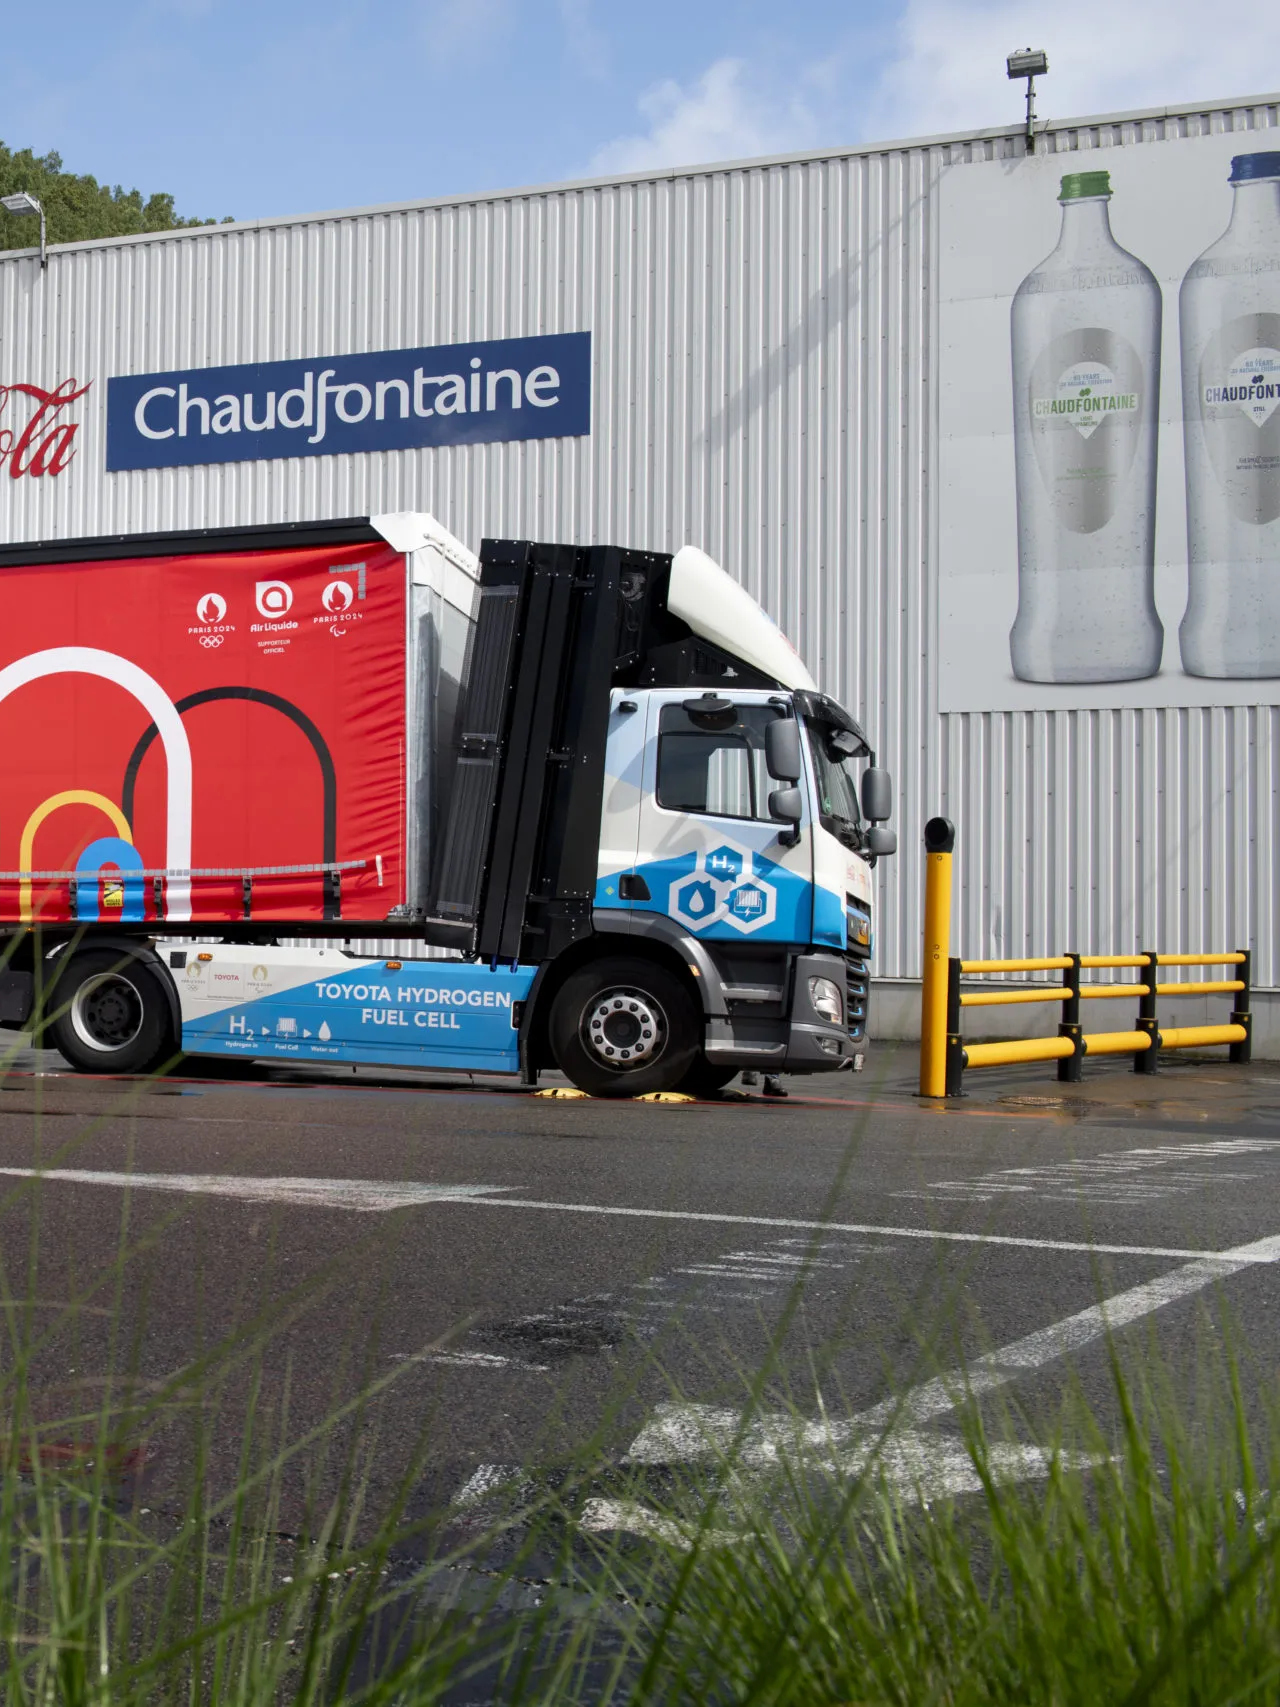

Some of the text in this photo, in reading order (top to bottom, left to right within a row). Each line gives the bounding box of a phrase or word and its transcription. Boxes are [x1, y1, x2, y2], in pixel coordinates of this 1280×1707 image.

[134, 357, 560, 444] Chaudfontaine
[1035, 394, 1136, 415] CHAUDFONTAINE
[313, 613, 363, 624] PARIS 2024
[188, 625, 236, 634] PARIS 2024
[250, 621, 299, 633] Air Liquide
[214, 974, 240, 982] TOYOTA
[315, 983, 511, 1008] TOYOTA HYDROGEN
[361, 1008, 461, 1029] FUEL CELL
